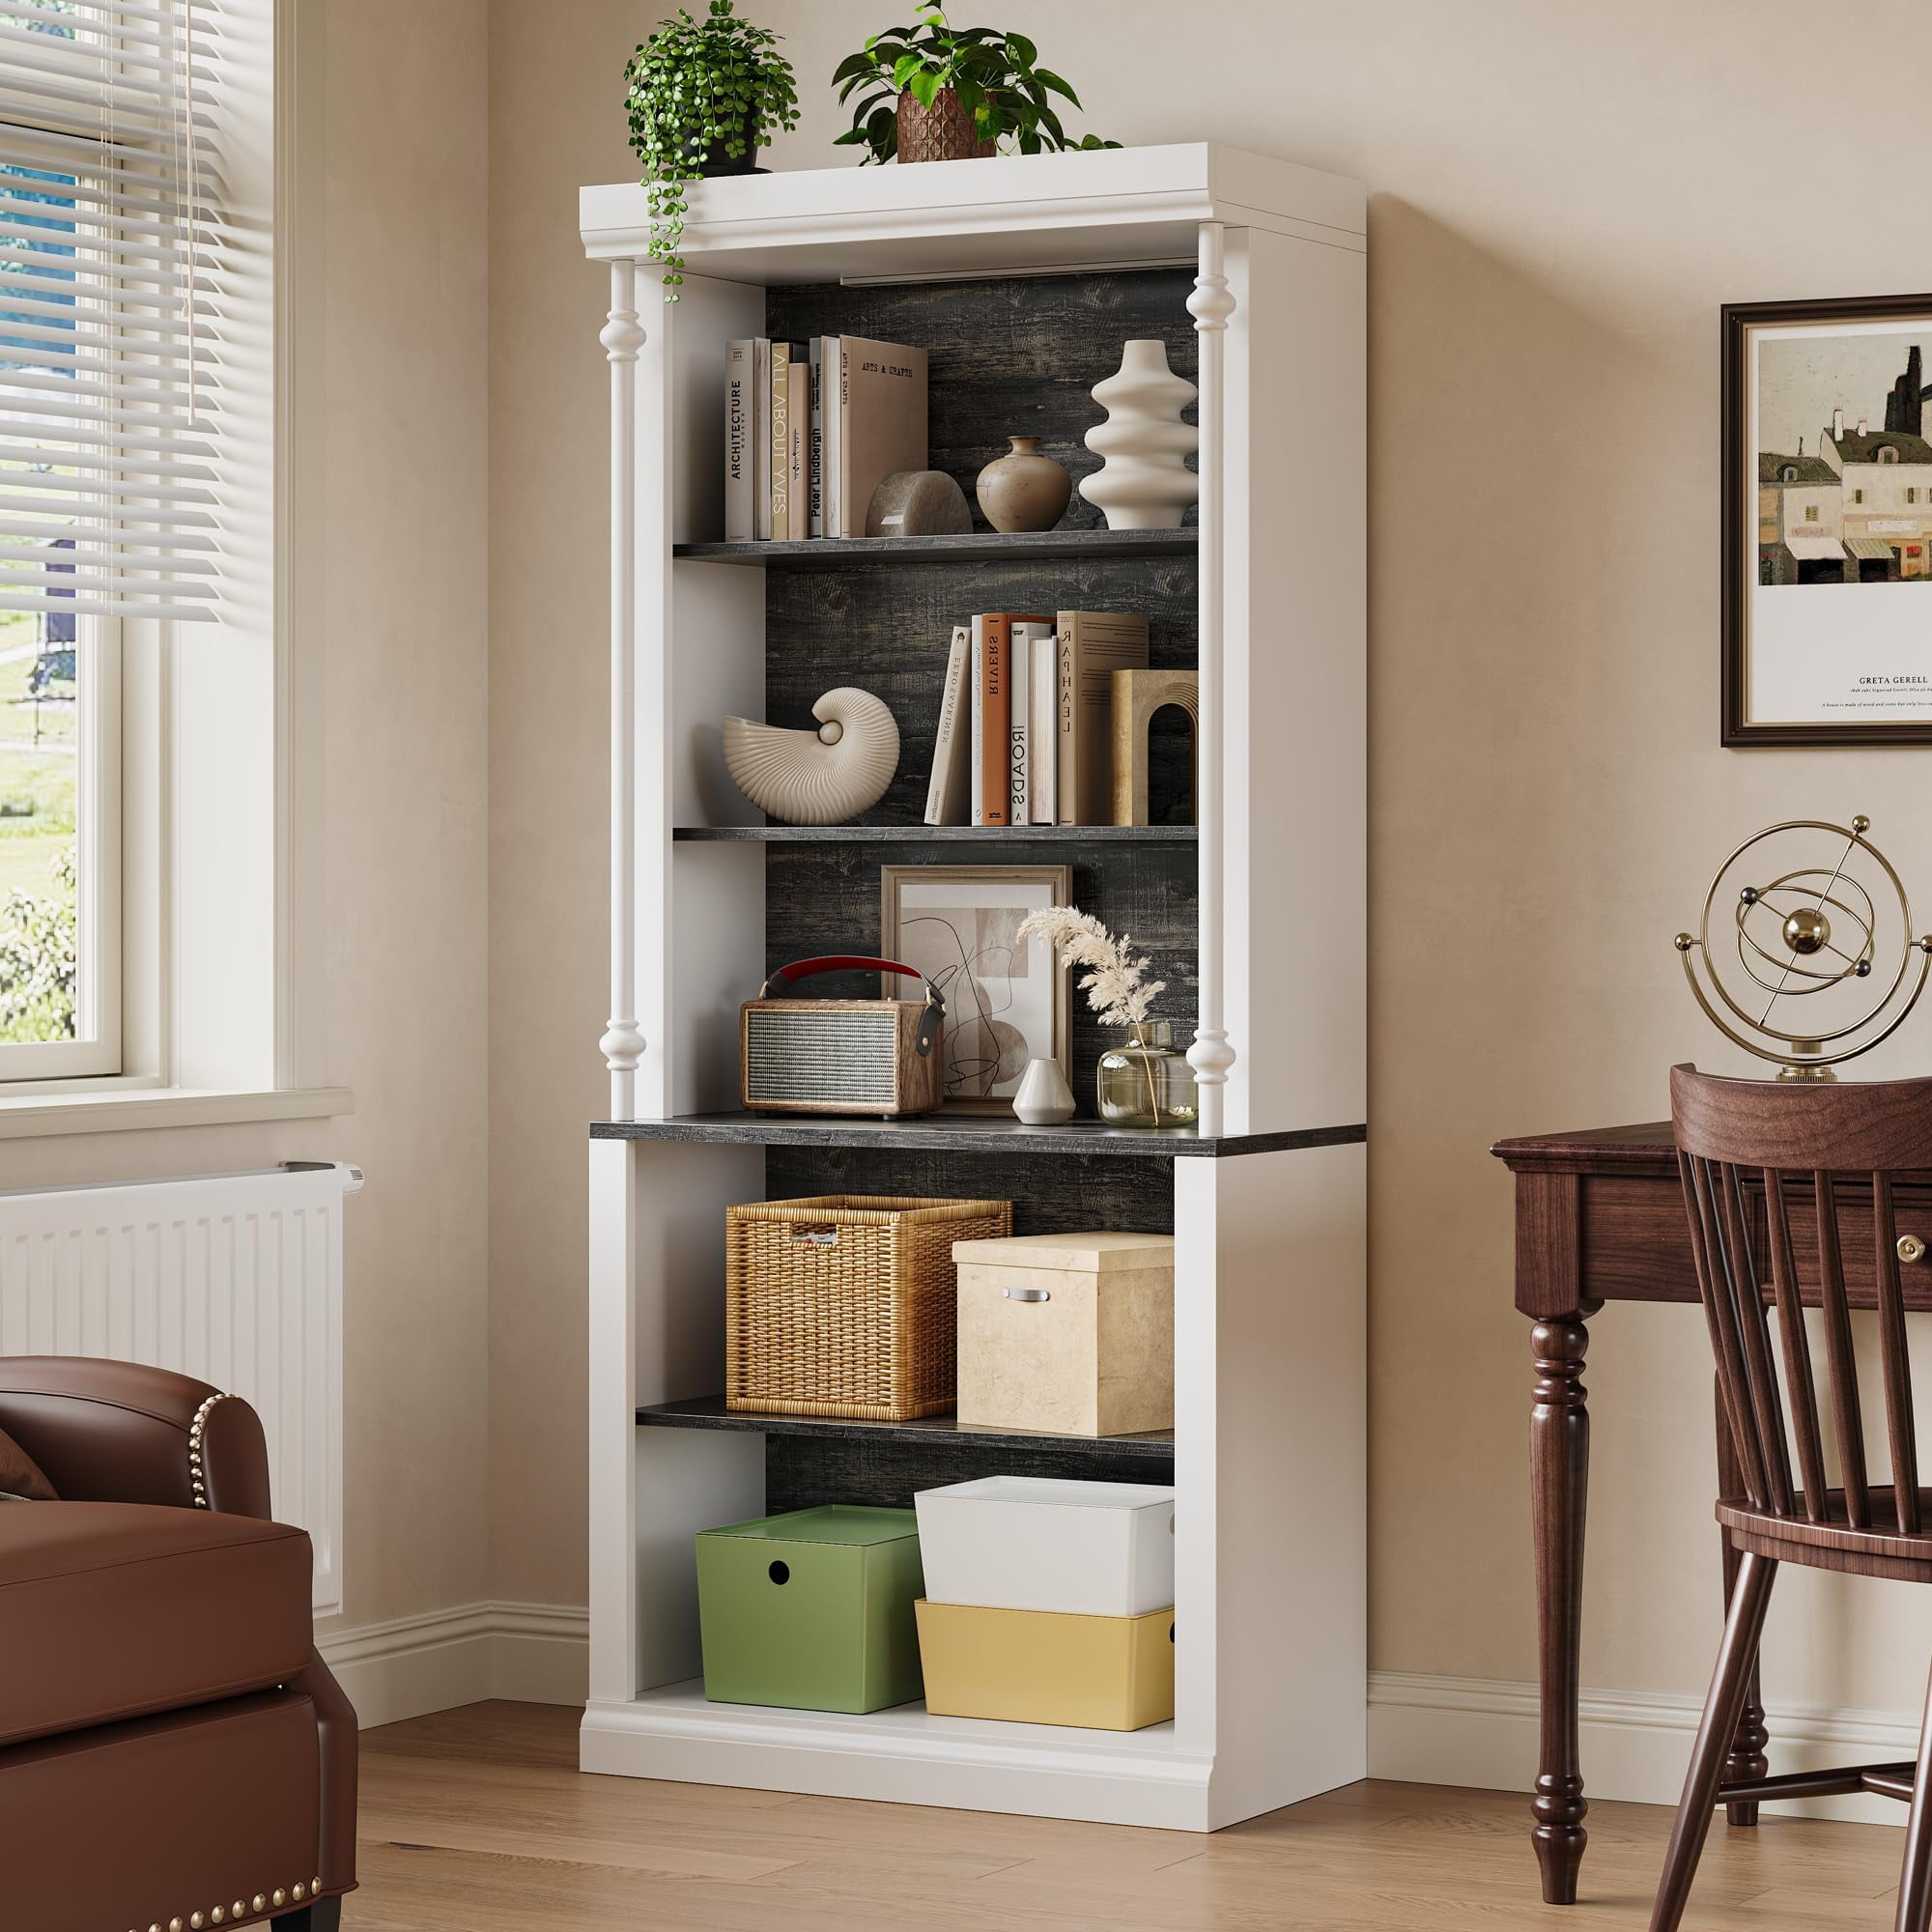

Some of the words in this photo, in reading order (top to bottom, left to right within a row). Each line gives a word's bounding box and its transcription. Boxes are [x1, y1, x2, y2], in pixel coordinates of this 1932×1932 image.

[773, 354, 785, 386] ALL
[862, 363, 878, 372] ARTS
[881, 365, 887, 374] &
[890, 366, 913, 378] CRAFTS
[731, 381, 740, 479] ARCHITECTURE
[773, 394, 786, 459] ABOUT
[811, 428, 821, 485] Lindbergh
[773, 468, 786, 513] YVES
[811, 488, 820, 517] Peter
